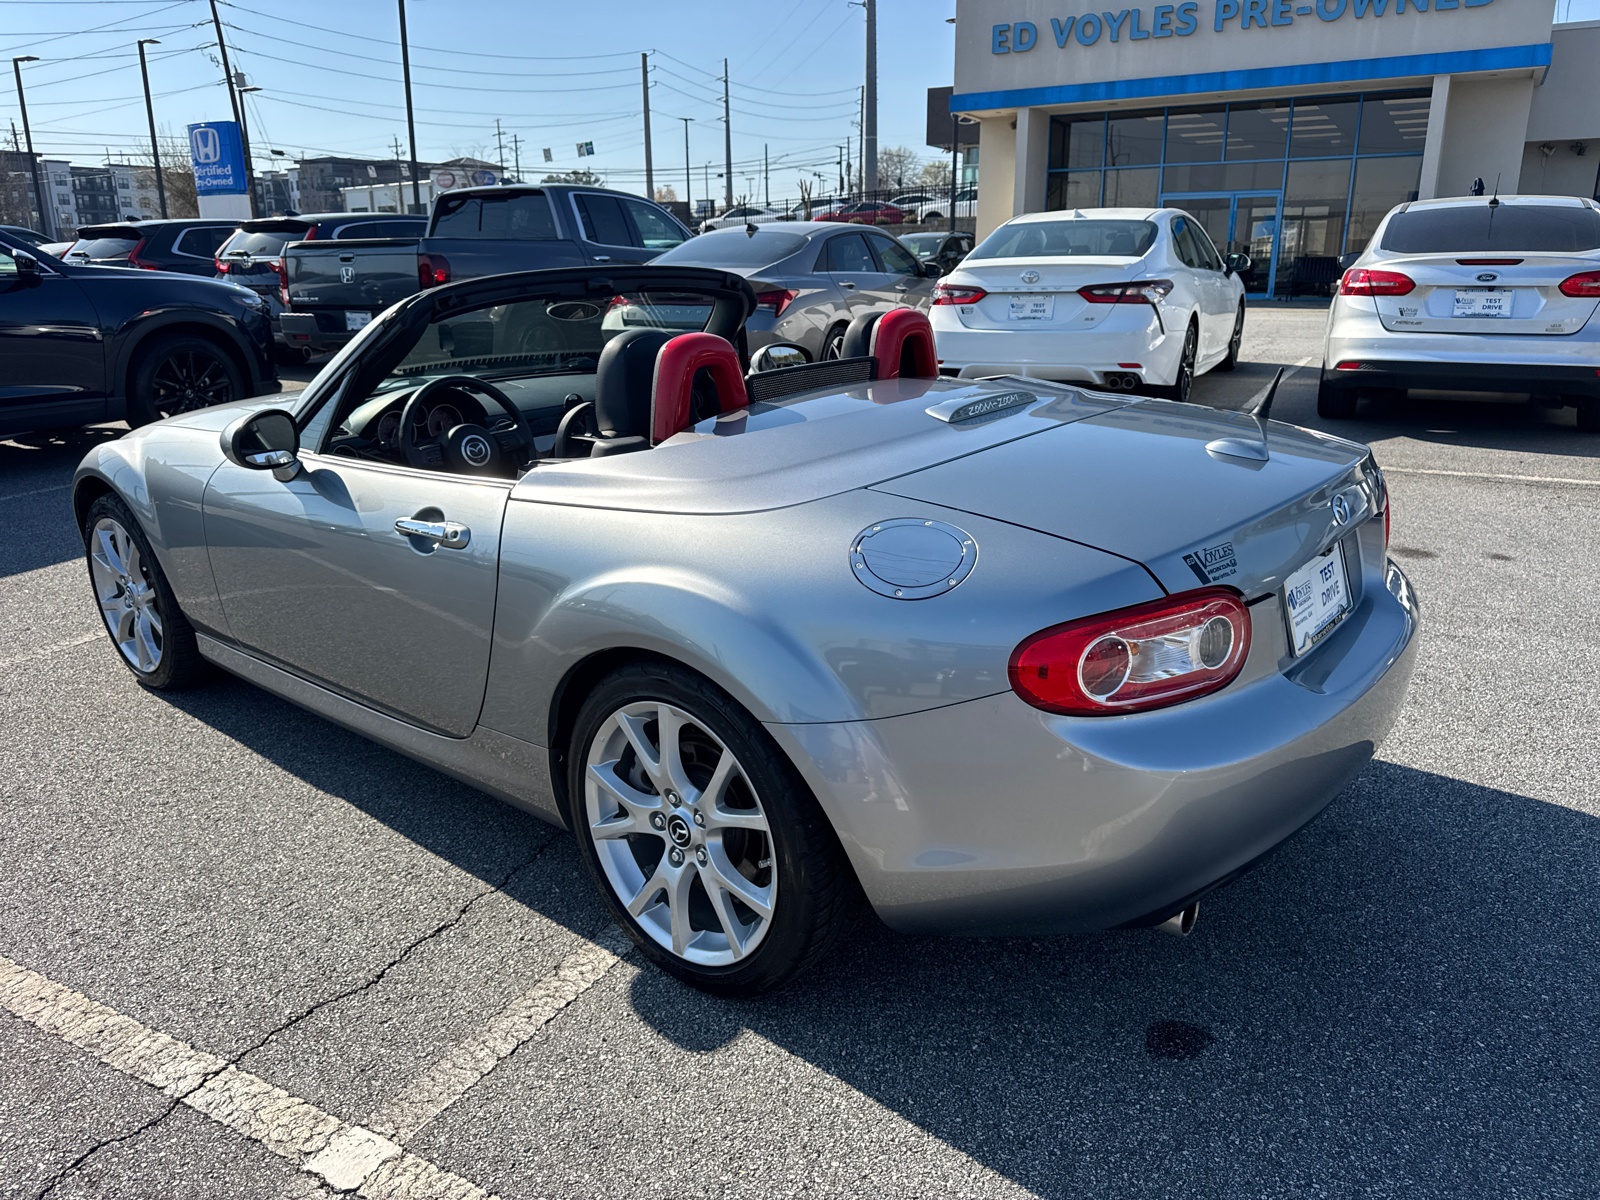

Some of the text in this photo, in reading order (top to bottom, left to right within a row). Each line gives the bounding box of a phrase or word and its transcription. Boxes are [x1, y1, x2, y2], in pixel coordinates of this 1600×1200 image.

[992, 0, 1493, 54] ED VOYLES PRE-OW
[194, 164, 232, 177] Certified
[968, 394, 1018, 415] ZOOM-ZOOM
[1193, 544, 1233, 569] VOYLES
[1207, 562, 1230, 575] HONDA
[1320, 561, 1335, 584] TEST
[1321, 580, 1340, 607] DRIVE
